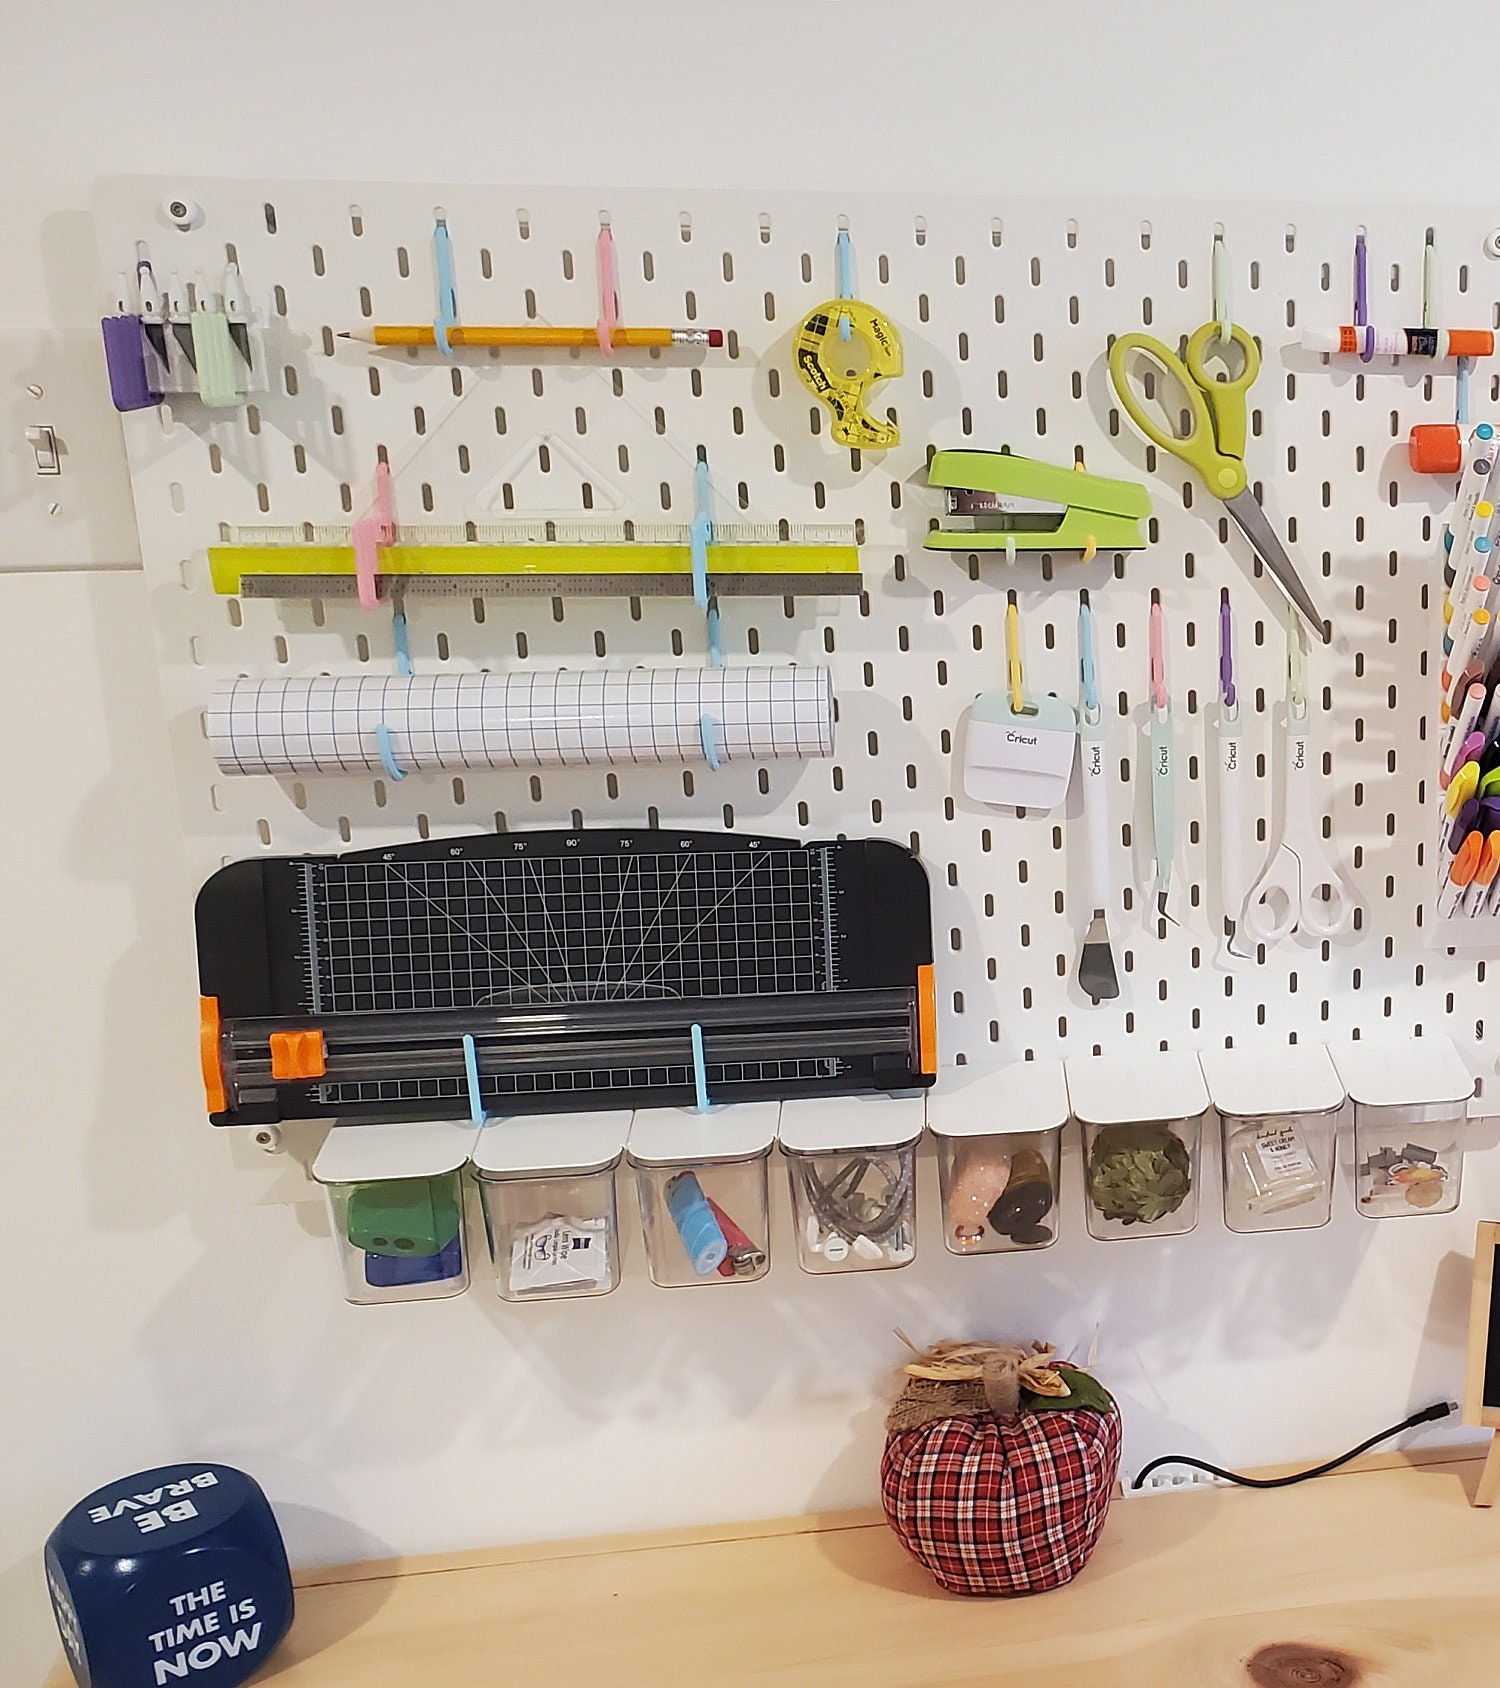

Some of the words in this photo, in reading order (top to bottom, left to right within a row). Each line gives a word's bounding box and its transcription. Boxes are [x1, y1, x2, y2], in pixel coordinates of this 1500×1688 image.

[870, 318, 889, 346] Magic
[803, 355, 826, 390] Scotch
[1006, 730, 1037, 745] Cricut
[1088, 746, 1101, 777] Cricut
[1157, 746, 1168, 777] Cricut
[1226, 742, 1237, 771] Cricut
[1292, 741, 1304, 770] Cricut
[87, 1471, 219, 1523] BRAVE
[132, 1499, 200, 1534] BE
[169, 1580, 227, 1616] THE
[148, 1611, 220, 1653] TIME
[229, 1598, 257, 1624] IS
[153, 1622, 262, 1686] NOW
